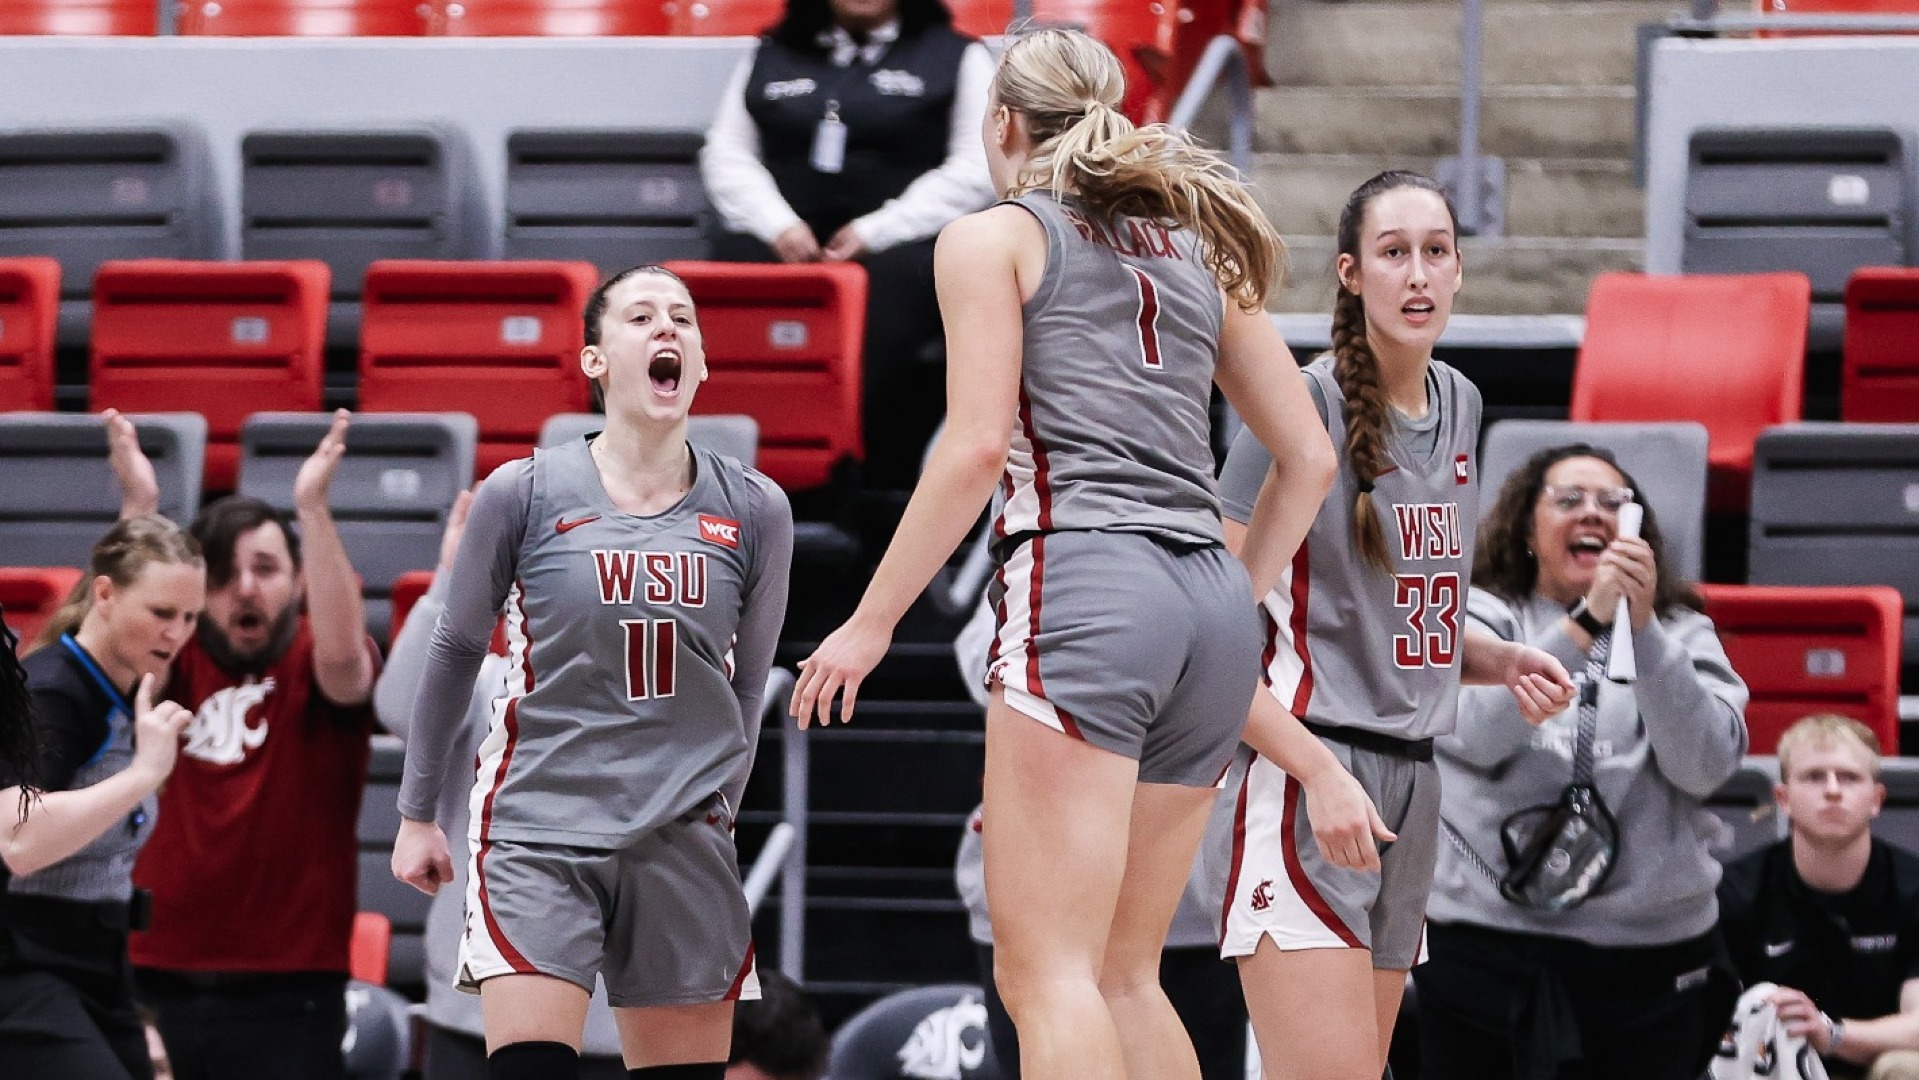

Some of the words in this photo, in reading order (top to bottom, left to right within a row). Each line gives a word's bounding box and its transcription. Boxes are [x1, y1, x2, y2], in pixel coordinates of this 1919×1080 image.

[1120, 263, 1163, 369] 1
[700, 519, 738, 543] WCC
[1392, 503, 1462, 560] WSU
[590, 550, 707, 608] WSU
[1393, 572, 1460, 669] 33
[618, 618, 677, 701] 11
